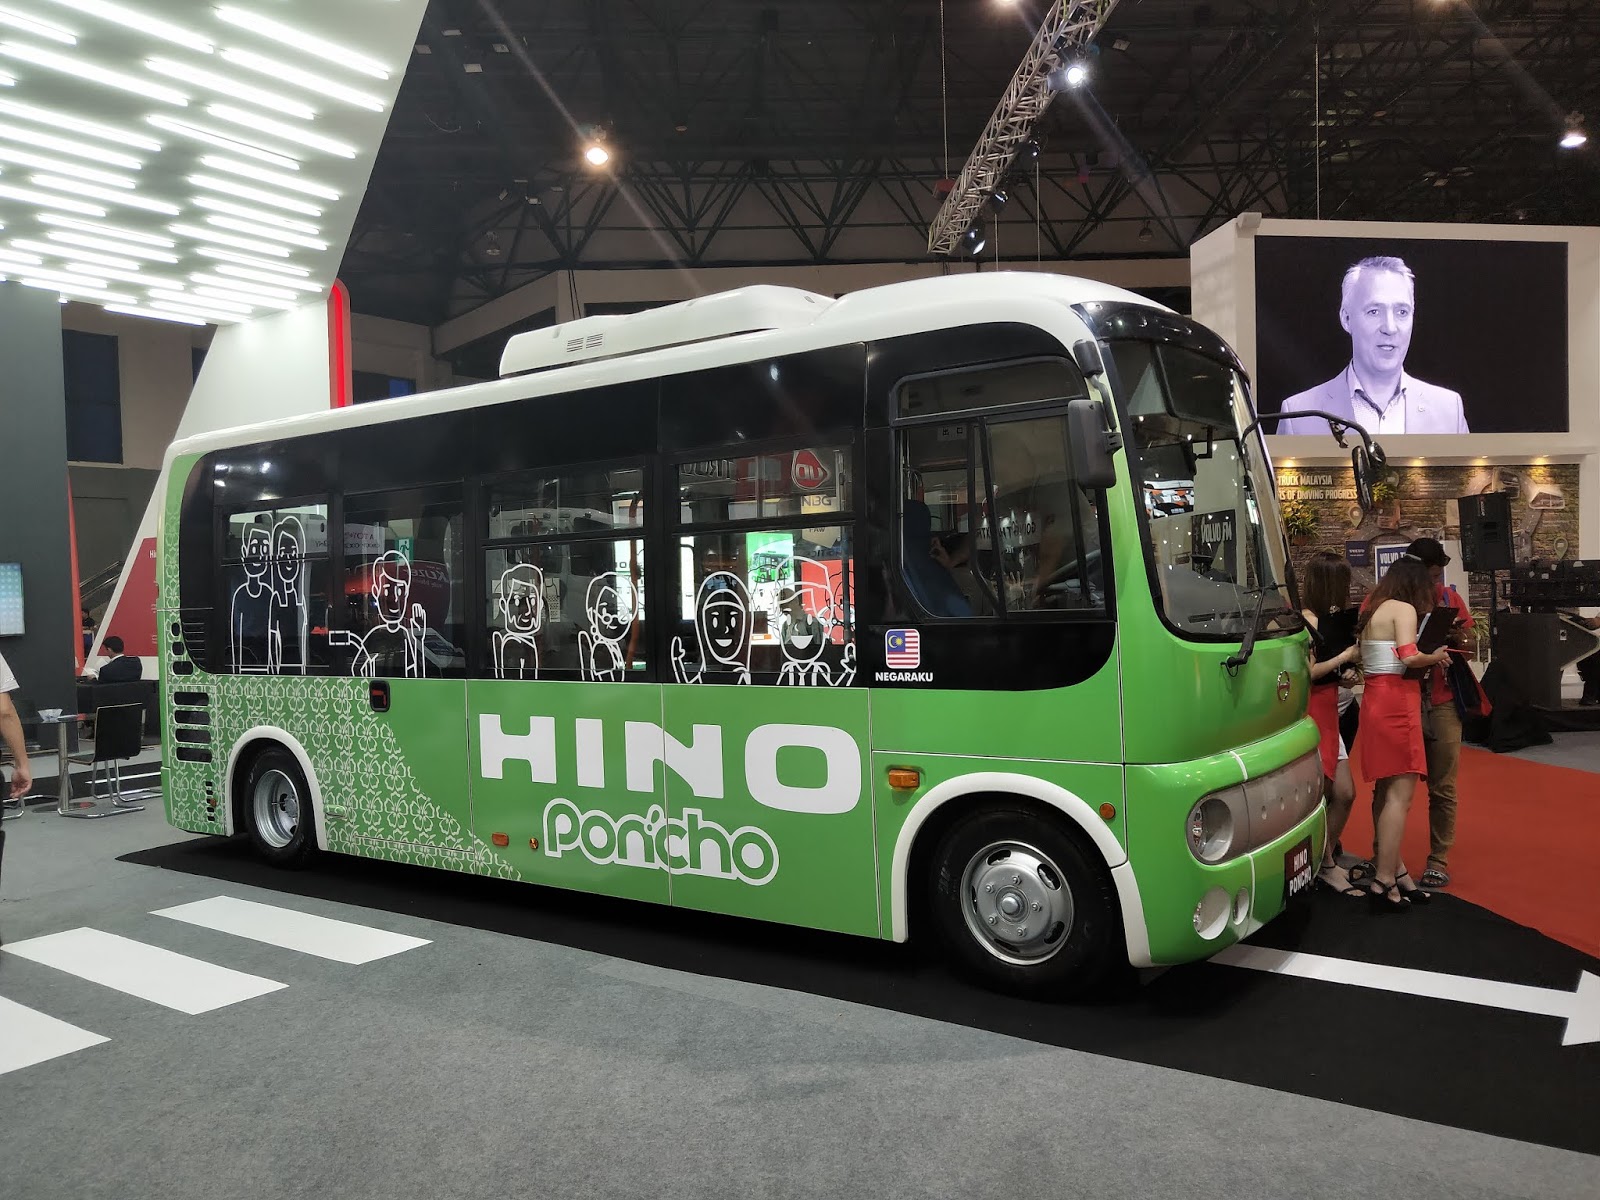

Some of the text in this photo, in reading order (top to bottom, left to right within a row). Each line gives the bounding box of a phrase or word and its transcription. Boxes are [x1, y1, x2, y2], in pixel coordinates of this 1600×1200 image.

[1300, 475, 1333, 486] MALAYSIA
[1287, 489, 1297, 500] OF
[1297, 489, 1324, 500] DRIVING
[1325, 488, 1358, 500] PROGRESS
[1379, 551, 1399, 564] VOLVO
[875, 672, 934, 682] NEGARAKU
[479, 713, 862, 815] HINO
[1293, 848, 1308, 872] HINO
[1289, 865, 1312, 896] PONCHO
